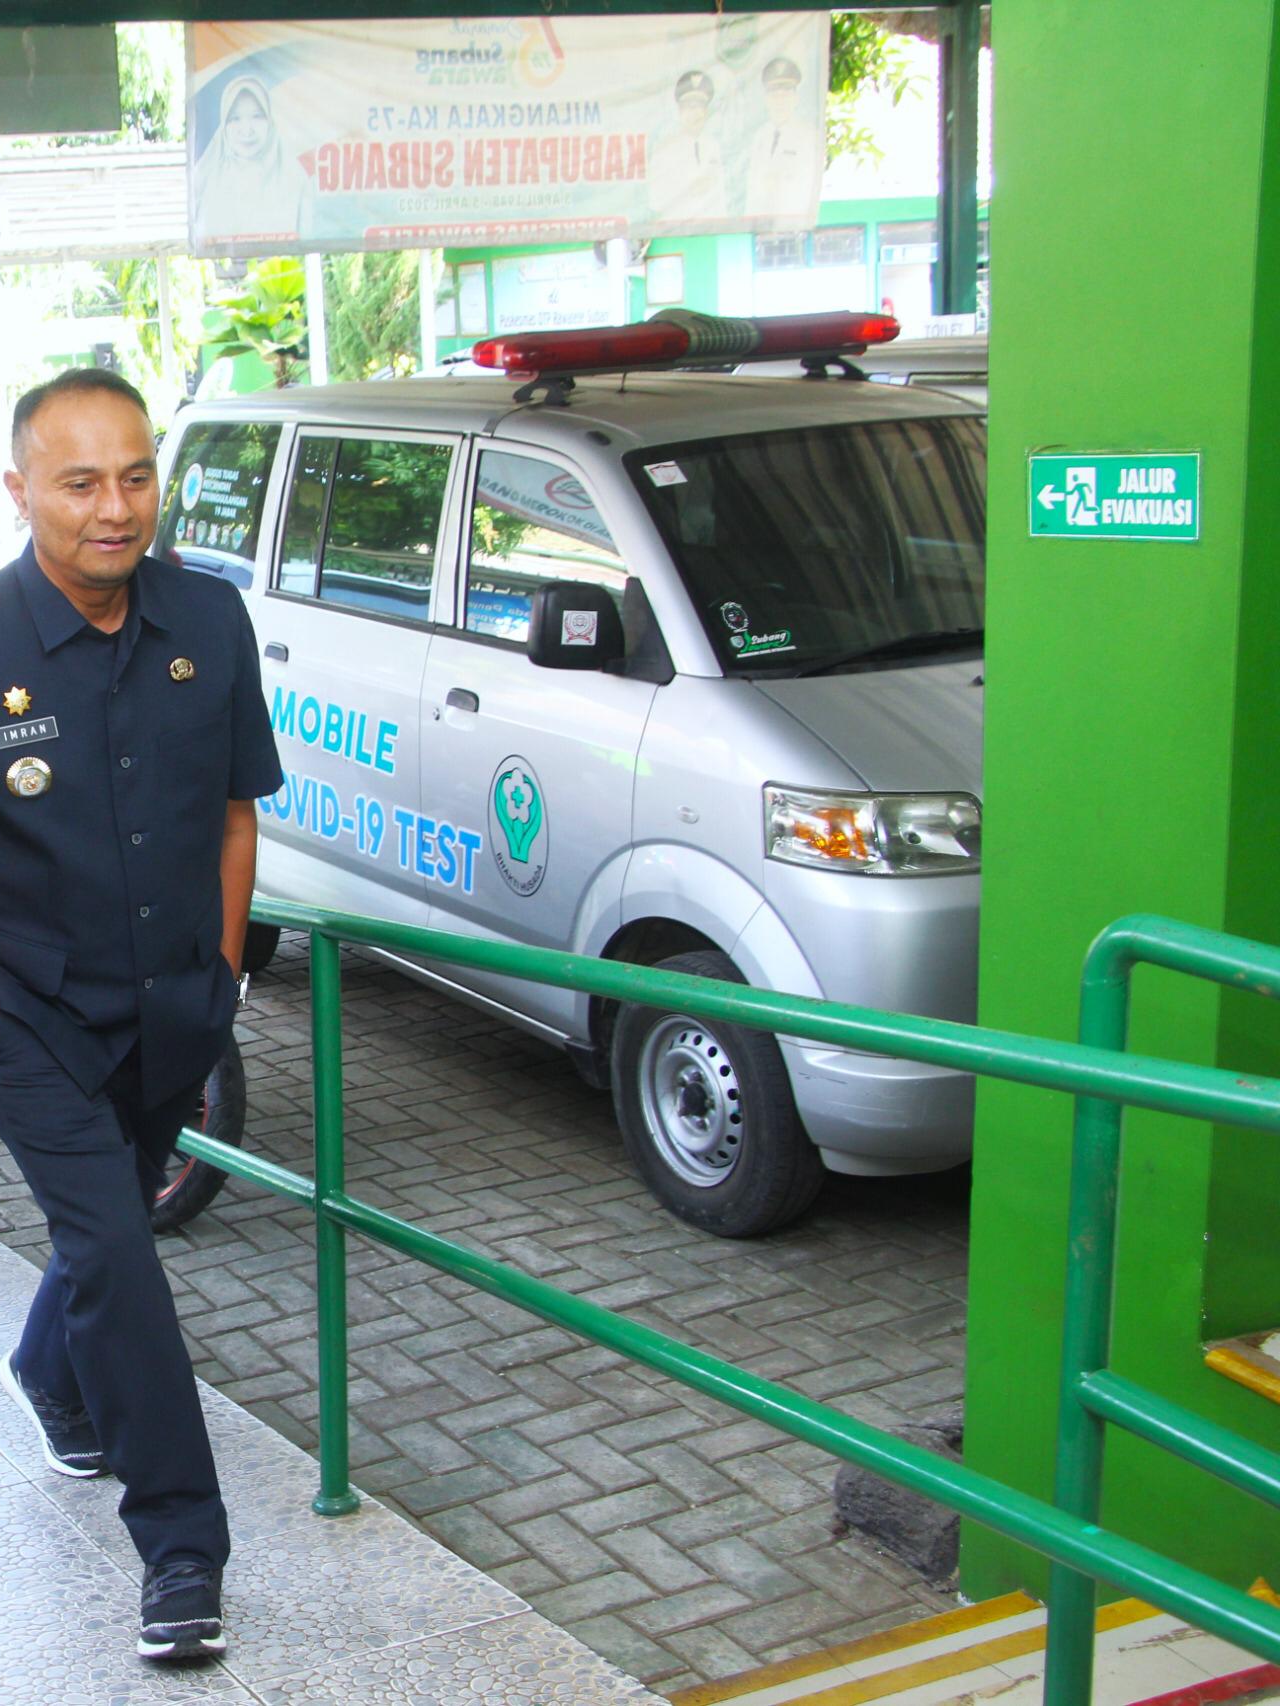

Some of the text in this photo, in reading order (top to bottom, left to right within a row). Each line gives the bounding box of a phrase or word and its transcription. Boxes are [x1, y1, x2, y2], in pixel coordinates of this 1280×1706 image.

[1117, 467, 1177, 494] JALUR
[1101, 498, 1193, 525] EVAKUASI
[3, 723, 47, 742] IMRAN
[270, 686, 399, 774] MOBILE
[394, 808, 481, 893] TEST
